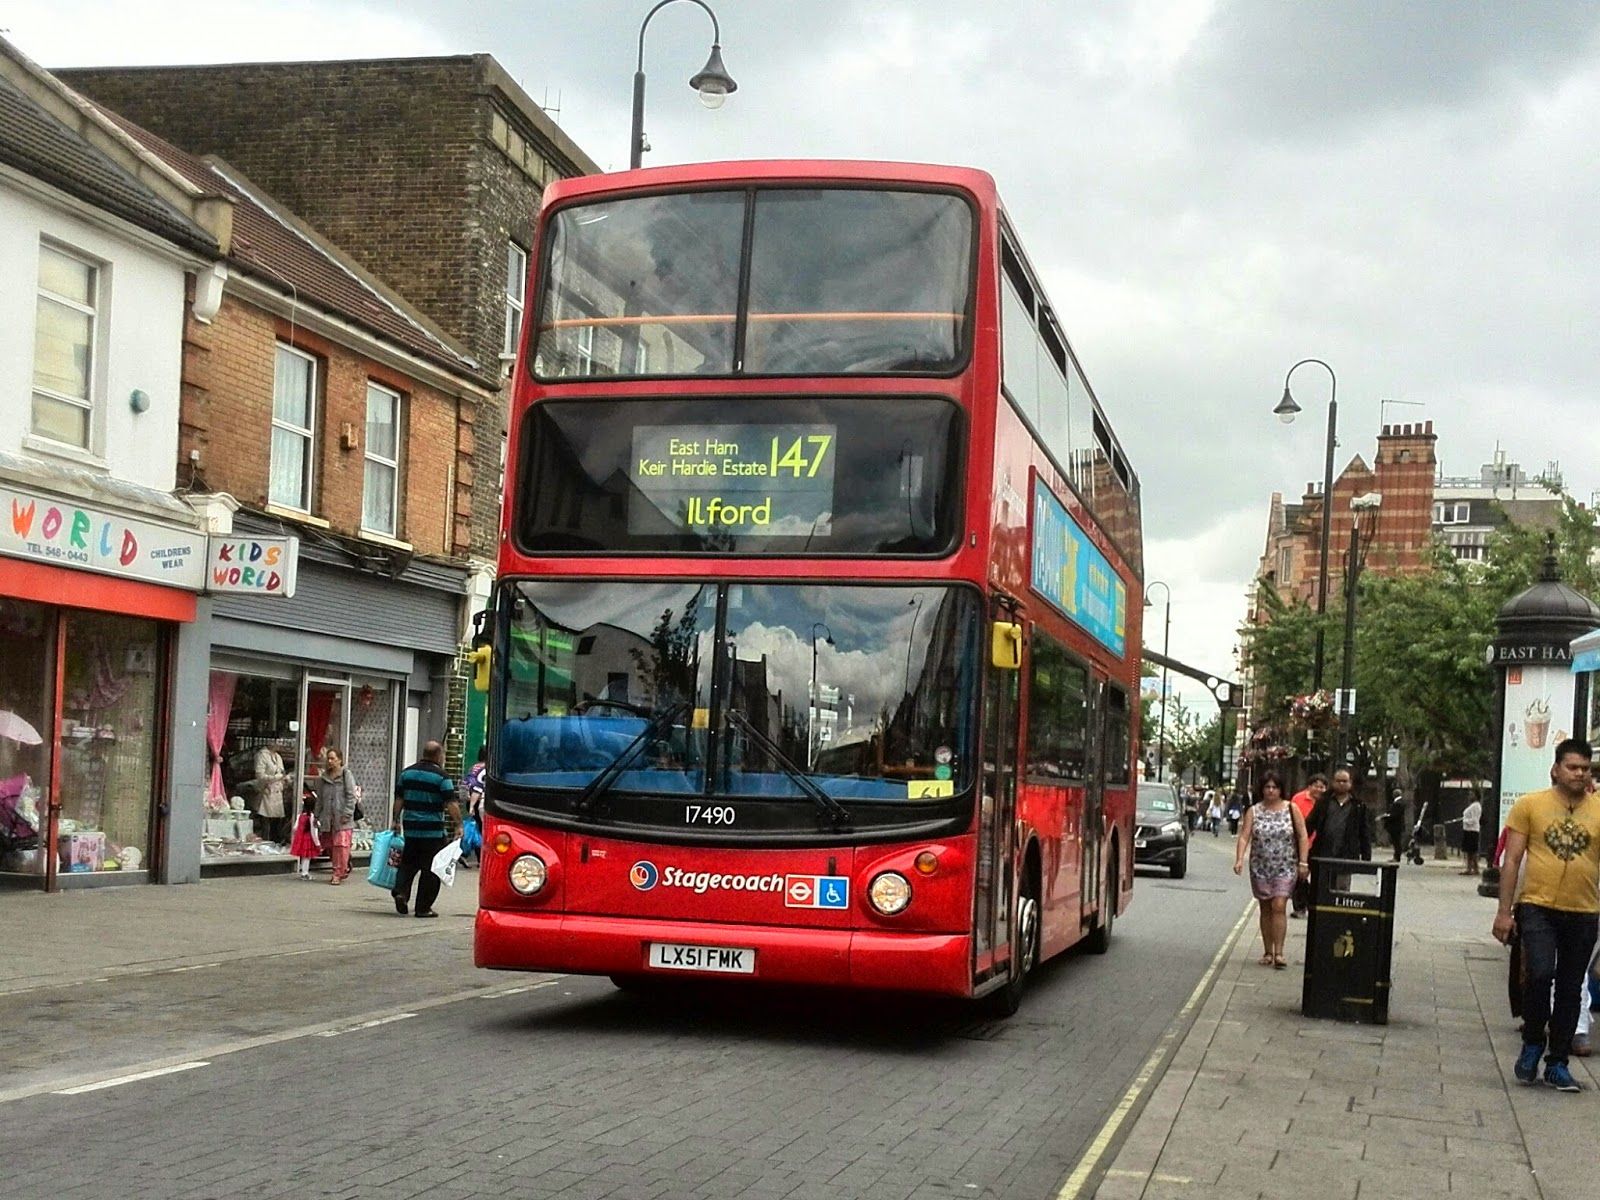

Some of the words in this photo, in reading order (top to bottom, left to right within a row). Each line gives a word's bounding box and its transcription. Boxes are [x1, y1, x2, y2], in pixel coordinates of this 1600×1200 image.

[669, 438, 699, 456] East
[705, 438, 739, 456] Ham
[770, 435, 832, 477] 147
[638, 459, 667, 476] Keir
[671, 459, 717, 476] Hardie
[722, 459, 768, 476] Estate
[687, 497, 771, 525] Ilford
[12, 498, 138, 567] WORLD
[26, 542, 43, 554] TEL
[150, 546, 192, 559] CHILDRENS
[218, 542, 282, 566] KIDS
[161, 558, 184, 569] WEAR
[213, 566, 281, 591] WORLD
[1499, 646, 1537, 660] EAST
[685, 805, 736, 825] 17490
[662, 866, 784, 894] Stagecoach
[1335, 898, 1365, 908] Litter
[660, 946, 702, 966] LX51
[706, 949, 743, 969] FMK
